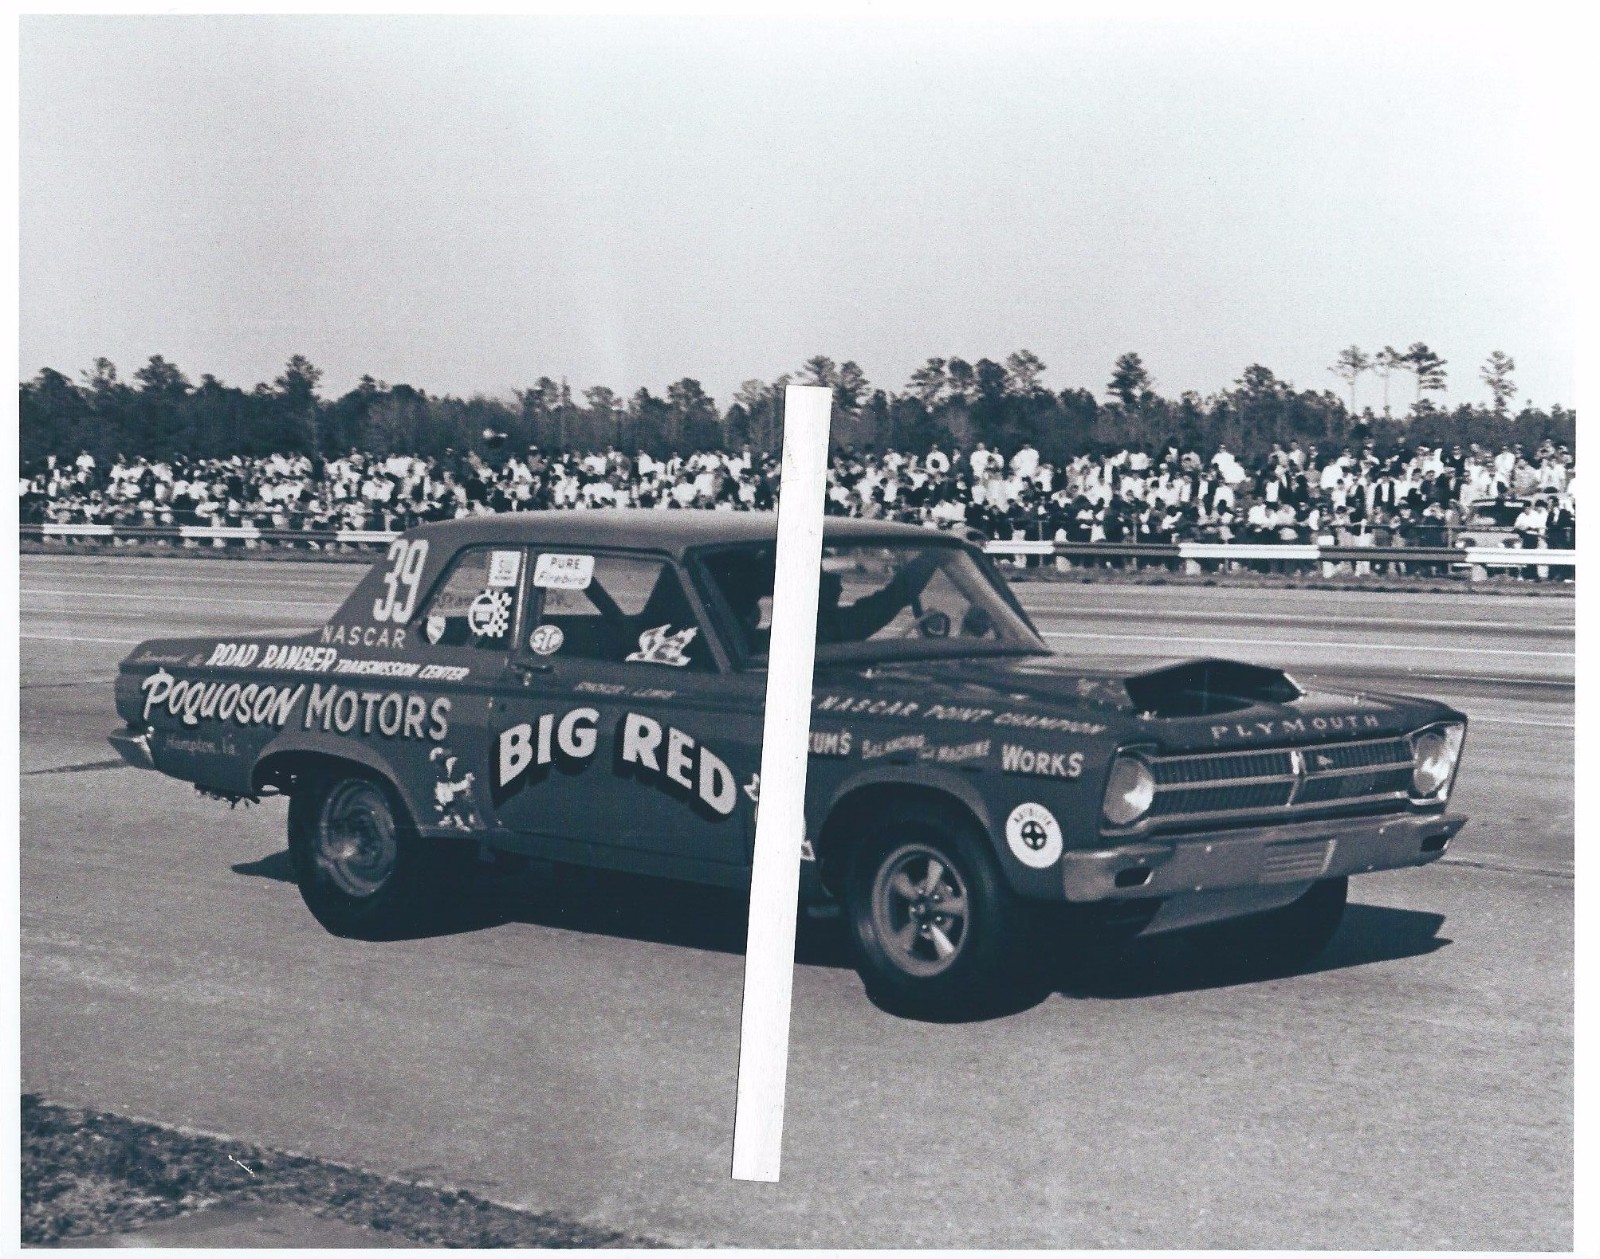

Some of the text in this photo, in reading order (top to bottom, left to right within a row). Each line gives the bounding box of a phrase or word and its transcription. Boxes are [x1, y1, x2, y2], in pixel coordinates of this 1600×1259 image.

[551, 557, 581, 569] PURE
[372, 539, 429, 623] 39
[321, 625, 406, 648] NASCAR
[532, 627, 562, 653] STP
[205, 643, 259, 667] ROAD
[257, 645, 337, 672] RANGER
[333, 659, 421, 677] TRANSMISSION
[418, 664, 470, 681] CENTER
[141, 667, 450, 741] POQUOSON MOTORS
[817, 695, 919, 716] NASCAR
[923, 704, 993, 722] POINT
[1211, 715, 1379, 740] PLYMOUTH
[499, 707, 737, 815] BIG RED
[1001, 743, 1084, 778] WORKS
